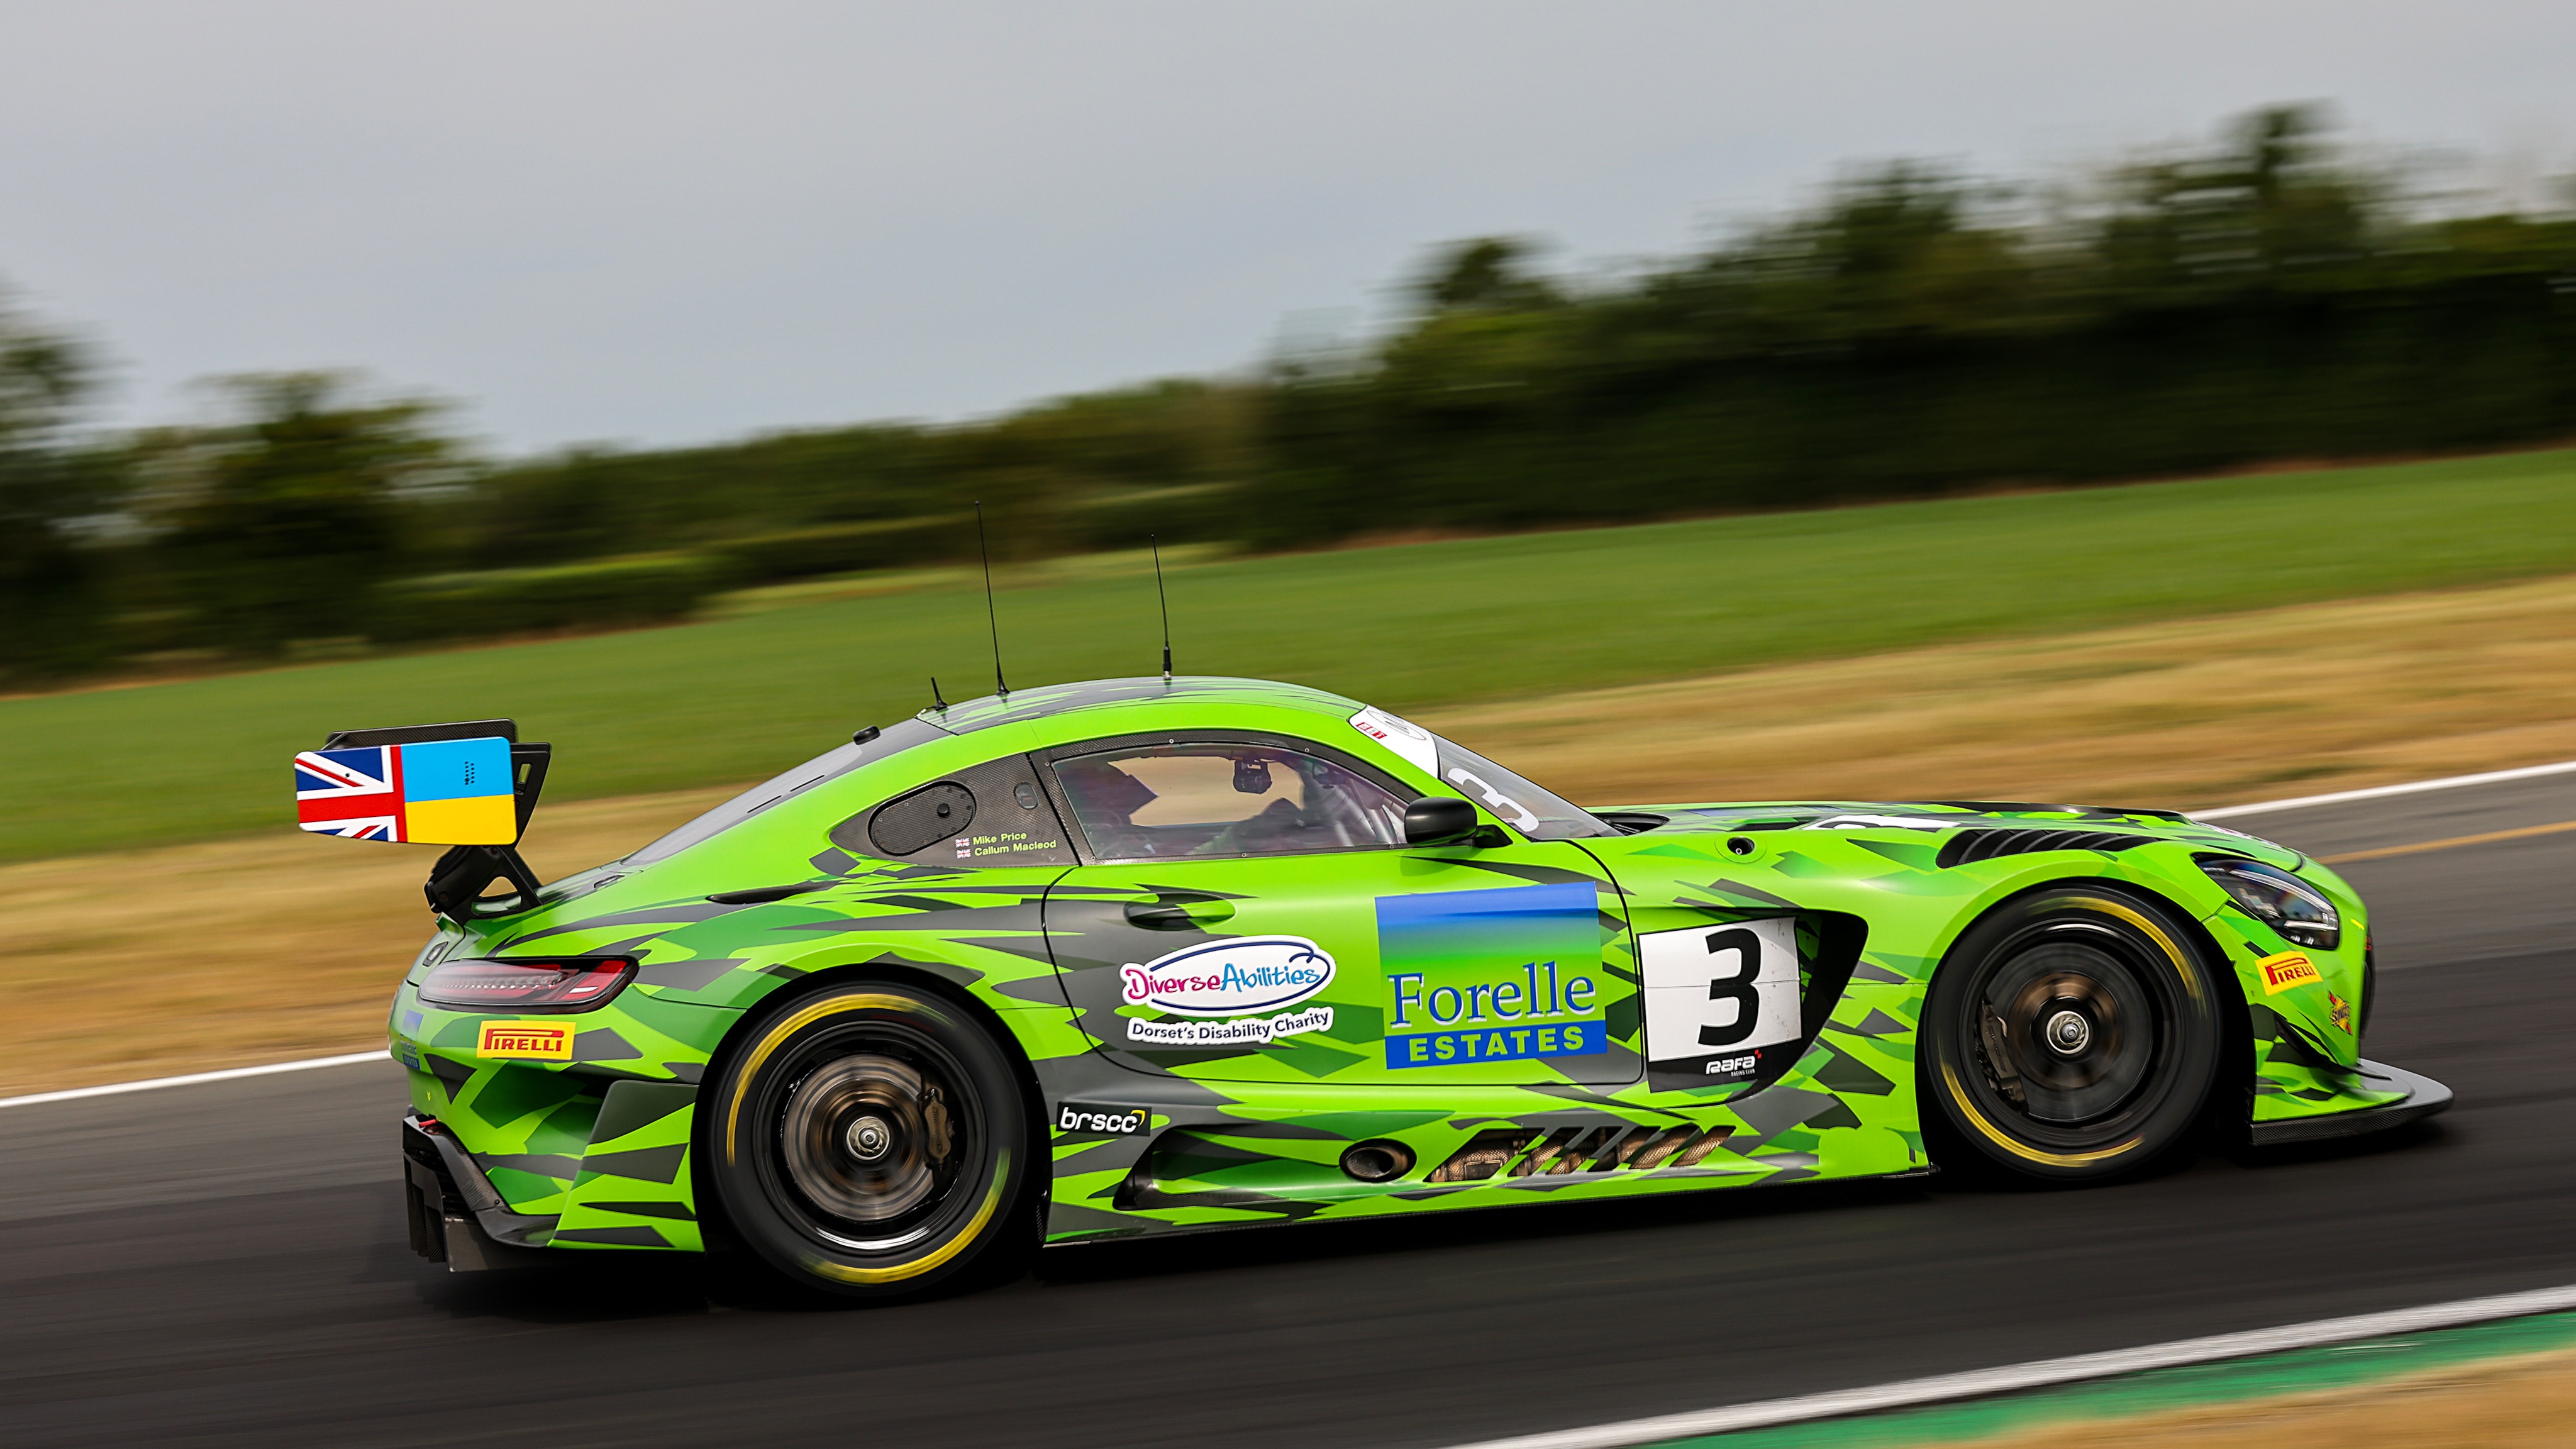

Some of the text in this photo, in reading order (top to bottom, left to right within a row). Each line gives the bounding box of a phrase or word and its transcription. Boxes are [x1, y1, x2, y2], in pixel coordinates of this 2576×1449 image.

[1448, 767, 1539, 832] 3
[973, 832, 1027, 845] Mike Price
[975, 840, 1057, 856] Callum Macleod
[1125, 963, 1320, 999] DiverseAbilities
[2265, 957, 2316, 985] PIRELLI
[1387, 960, 1596, 1029] Forelle
[1697, 928, 1761, 1046] 3
[1133, 1012, 1329, 1039] Dorset's Disability Charity
[484, 1028, 565, 1052] PIRELLI
[1409, 1026, 1584, 1062] ESTATES
[1060, 1107, 1138, 1133] brscc
